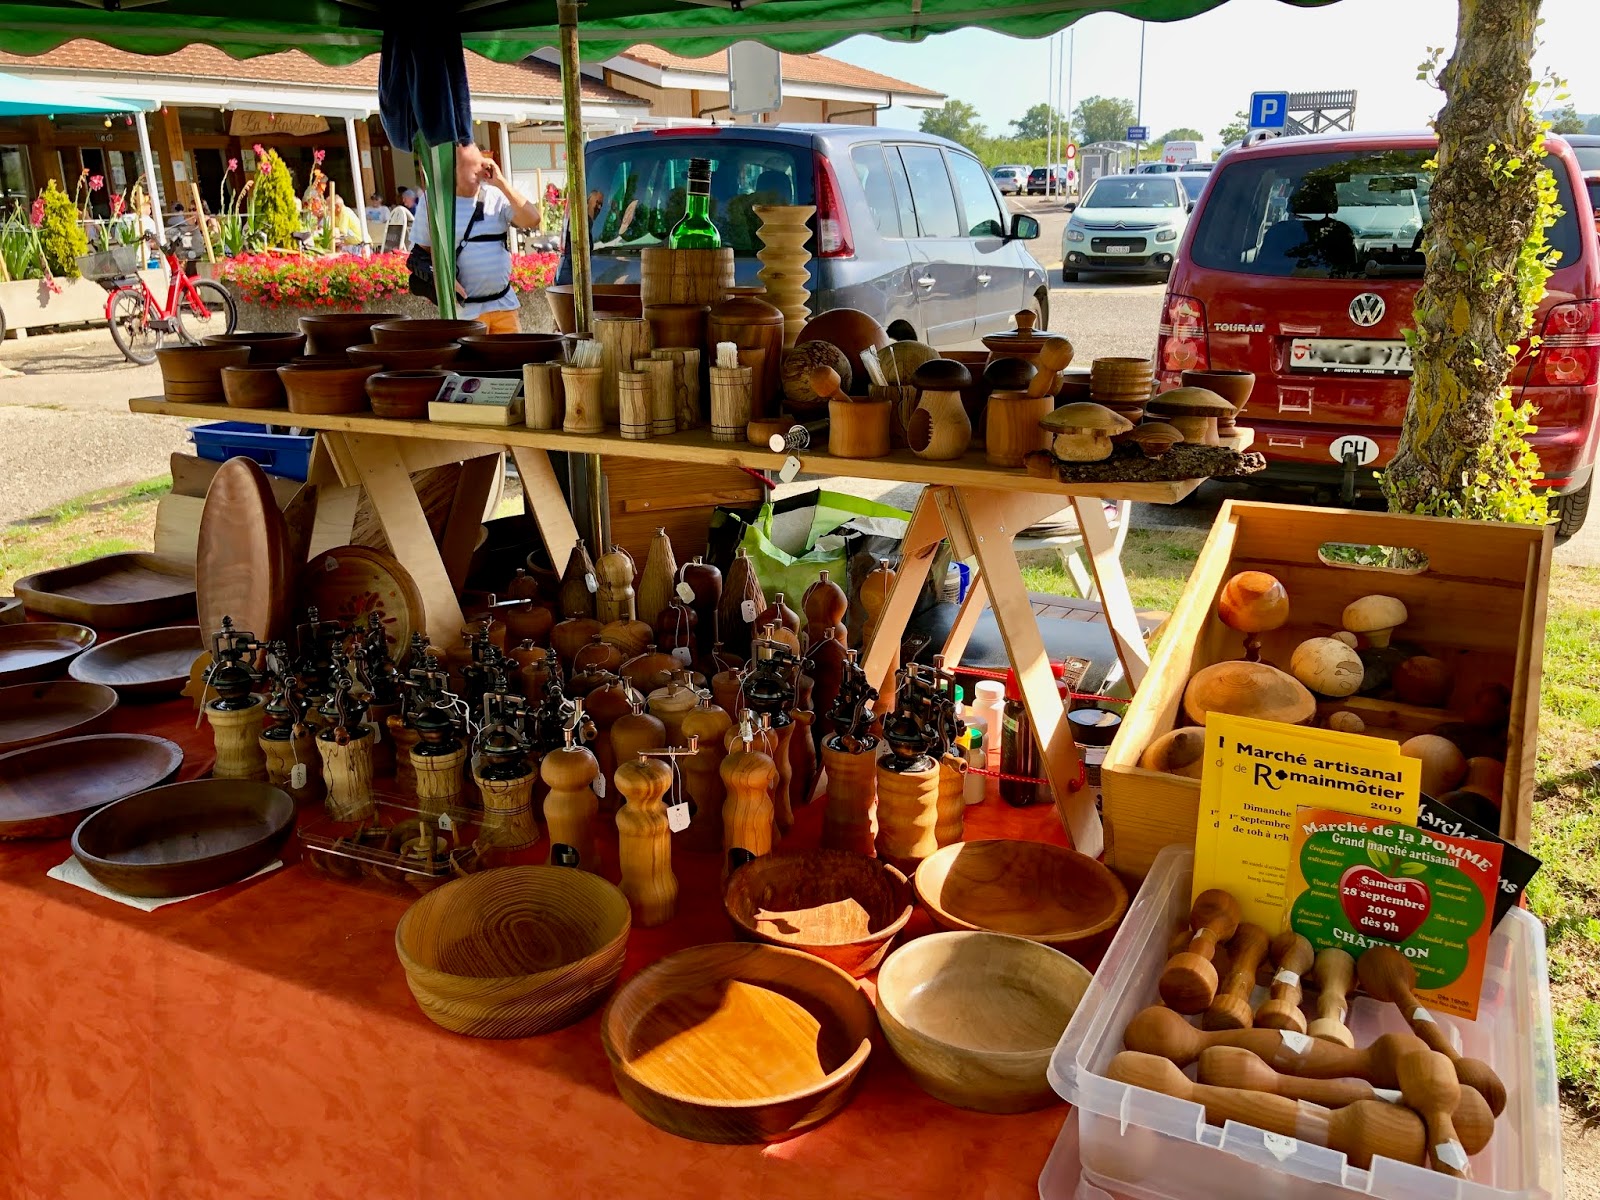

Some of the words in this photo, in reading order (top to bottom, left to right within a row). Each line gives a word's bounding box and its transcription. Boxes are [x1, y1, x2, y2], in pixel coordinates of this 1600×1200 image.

[1260, 98, 1278, 124] P
[1214, 322, 1265, 333] TOURAN
[1340, 439, 1367, 462] CH
[1233, 763, 1247, 774] de
[1236, 742, 1308, 766] Marché
[1313, 757, 1403, 783] artisanal
[1243, 802, 1292, 818] Dimanche
[1370, 802, 1402, 815] 2019
[1240, 815, 1291, 830] septembre
[1232, 824, 1245, 834] de
[1247, 826, 1263, 837] 10h
[1265, 830, 1271, 839] à
[1274, 832, 1289, 842] 17h
[1302, 821, 1368, 836] Marché
[1372, 824, 1394, 838] de
[1397, 828, 1415, 843] la
[1418, 834, 1493, 873] POMME
[1331, 832, 1365, 848] Grand
[1367, 841, 1408, 857] marché
[1409, 849, 1460, 868] artisanal
[1360, 875, 1407, 893] Samedi
[1342, 887, 1358, 896] 28
[1359, 890, 1426, 911] septembre
[1367, 904, 1397, 919] 2019
[1360, 916, 1381, 928] dès
[1382, 921, 1400, 933] 9h
